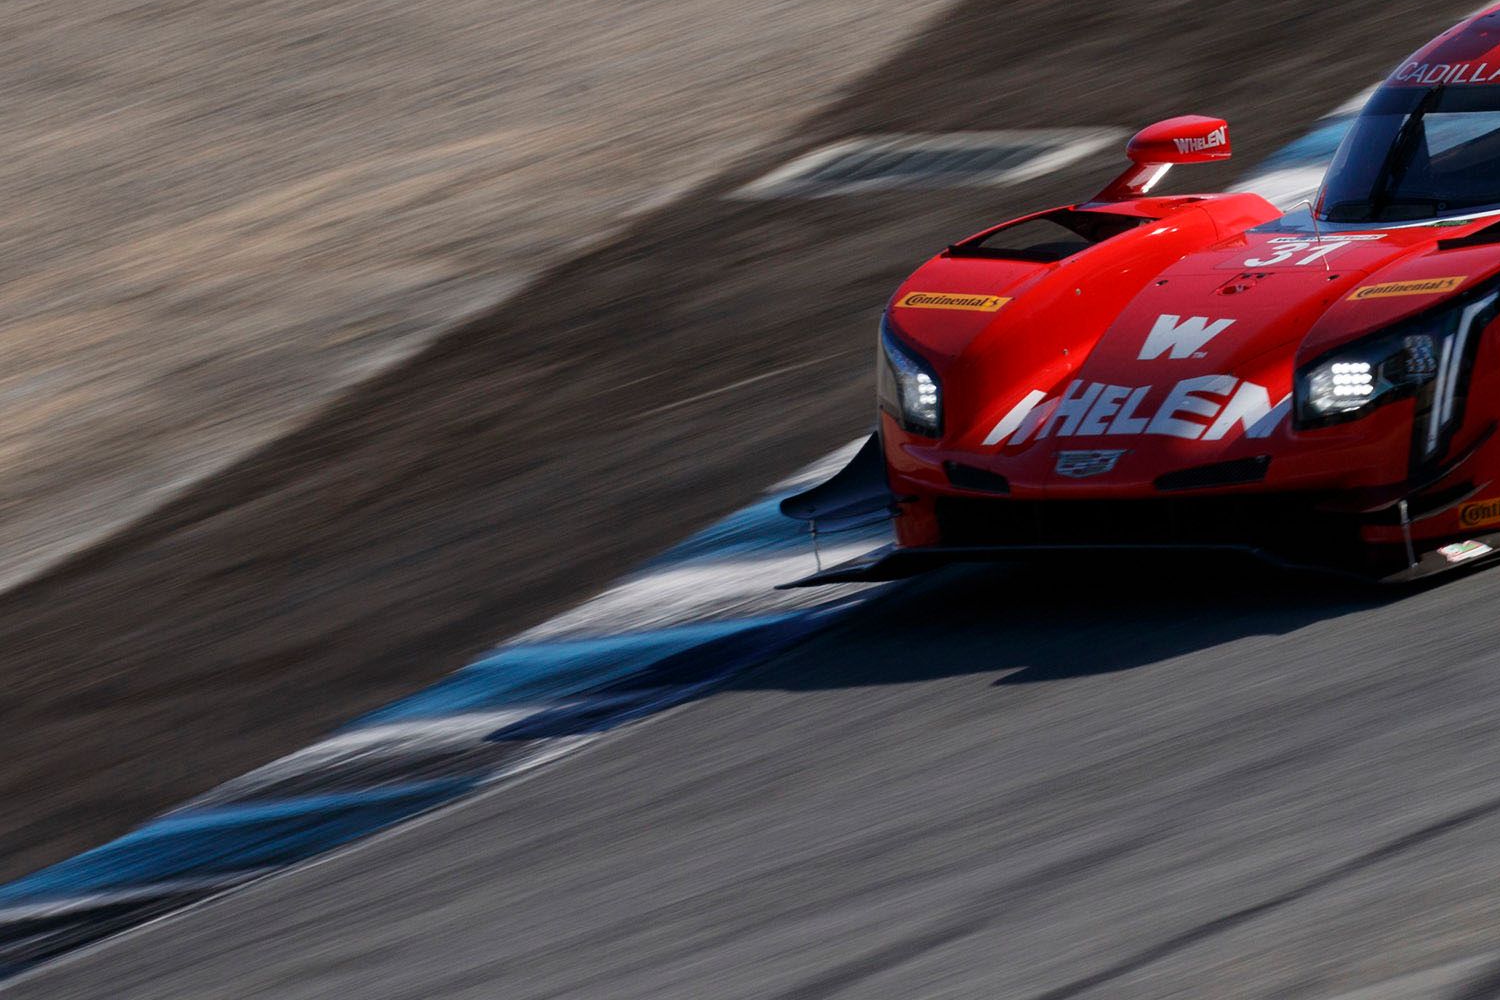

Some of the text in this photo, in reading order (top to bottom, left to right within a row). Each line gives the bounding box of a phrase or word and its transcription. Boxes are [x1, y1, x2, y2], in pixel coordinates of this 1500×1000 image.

[1173, 126, 1226, 154] WHELEN
[1244, 240, 1352, 267] 31
[905, 293, 989, 308] Continental
[1356, 279, 1444, 298] Continental
[1136, 313, 1237, 360] W
[981, 374, 1293, 446] WHELEN
